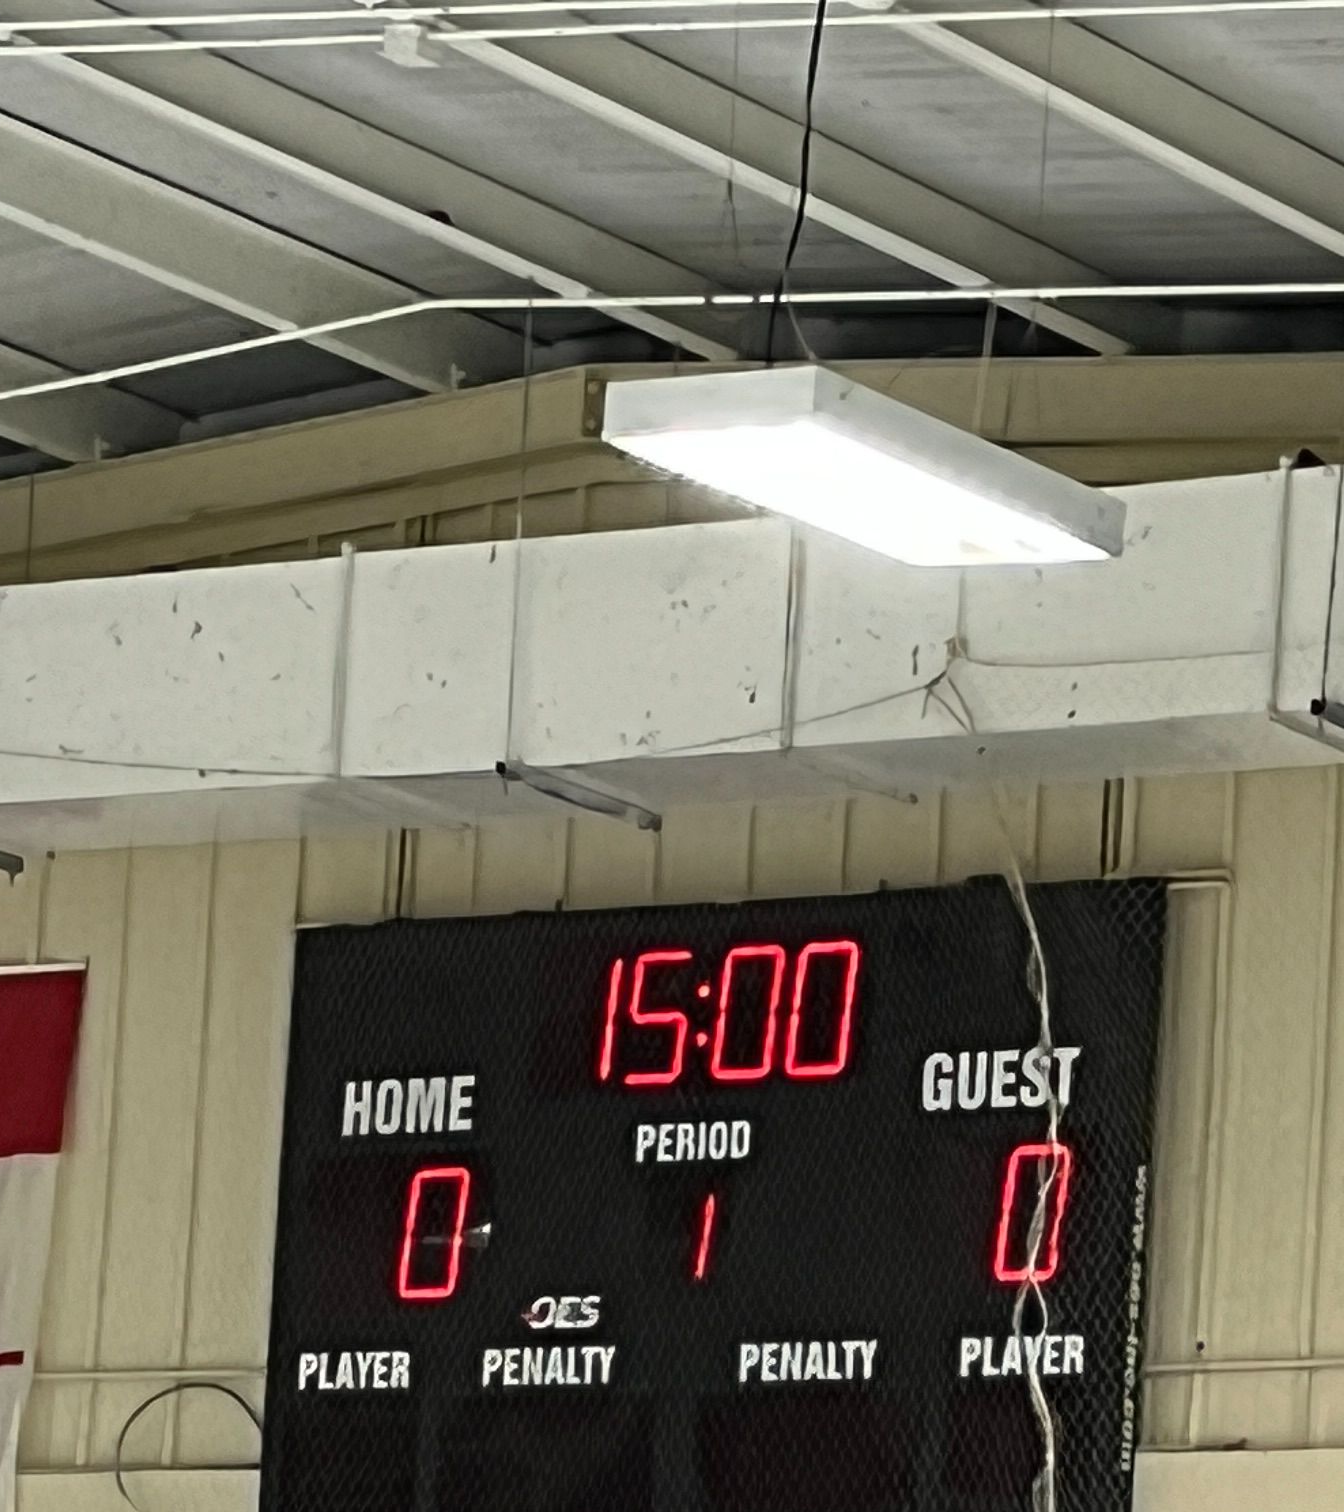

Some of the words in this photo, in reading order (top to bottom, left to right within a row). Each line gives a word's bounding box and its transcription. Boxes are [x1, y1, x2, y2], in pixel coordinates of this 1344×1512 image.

[599, 940, 859, 1086] 15:00
[922, 1046, 1082, 1112] GUEST
[341, 1075, 475, 1136] HOME
[635, 1120, 751, 1163] PERIOD
[399, 1167, 470, 1298] 0
[695, 1194, 715, 1280] 1
[994, 1143, 1071, 1282] 0
[522, 1296, 601, 1329] OES
[298, 1351, 410, 1390] PLAYER
[482, 1345, 616, 1387] PENALTY
[739, 1339, 877, 1383] PENALTY
[959, 1334, 1085, 1377] PLAYER
